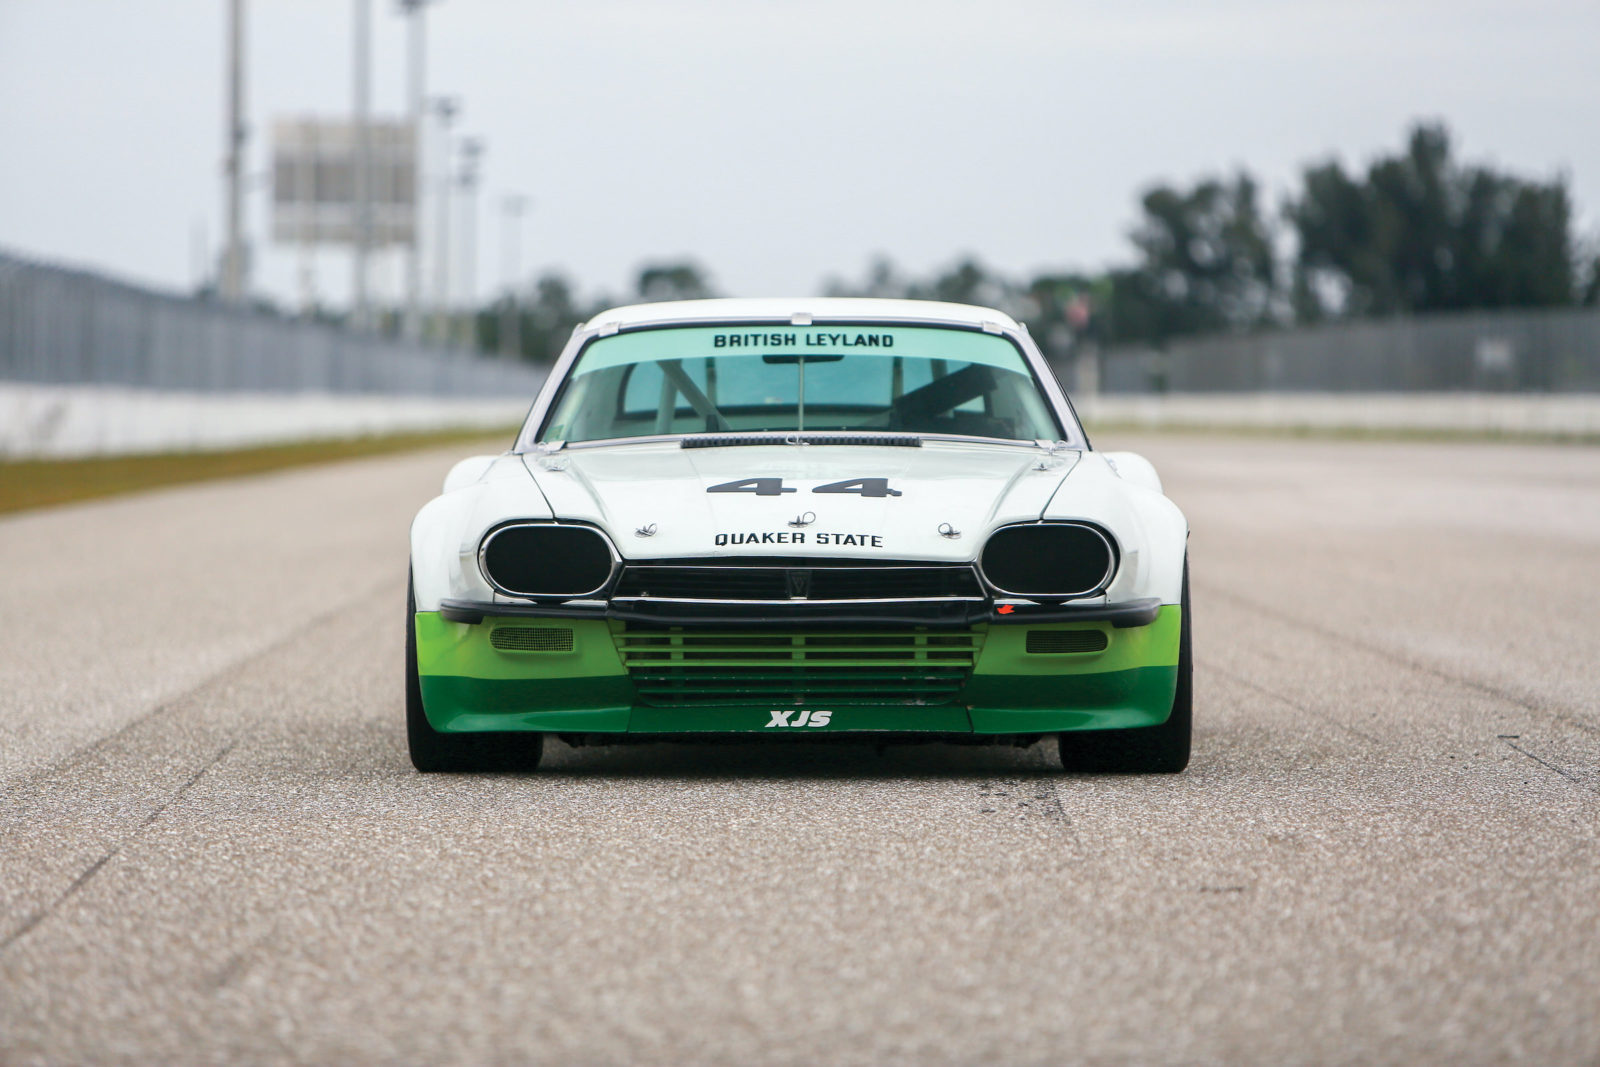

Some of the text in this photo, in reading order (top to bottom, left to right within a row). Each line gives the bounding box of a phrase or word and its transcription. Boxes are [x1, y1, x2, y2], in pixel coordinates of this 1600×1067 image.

[714, 333, 894, 348] BRITISH LEYLAND
[715, 532, 883, 548] QUAKER STATE
[764, 710, 833, 728] XJS
